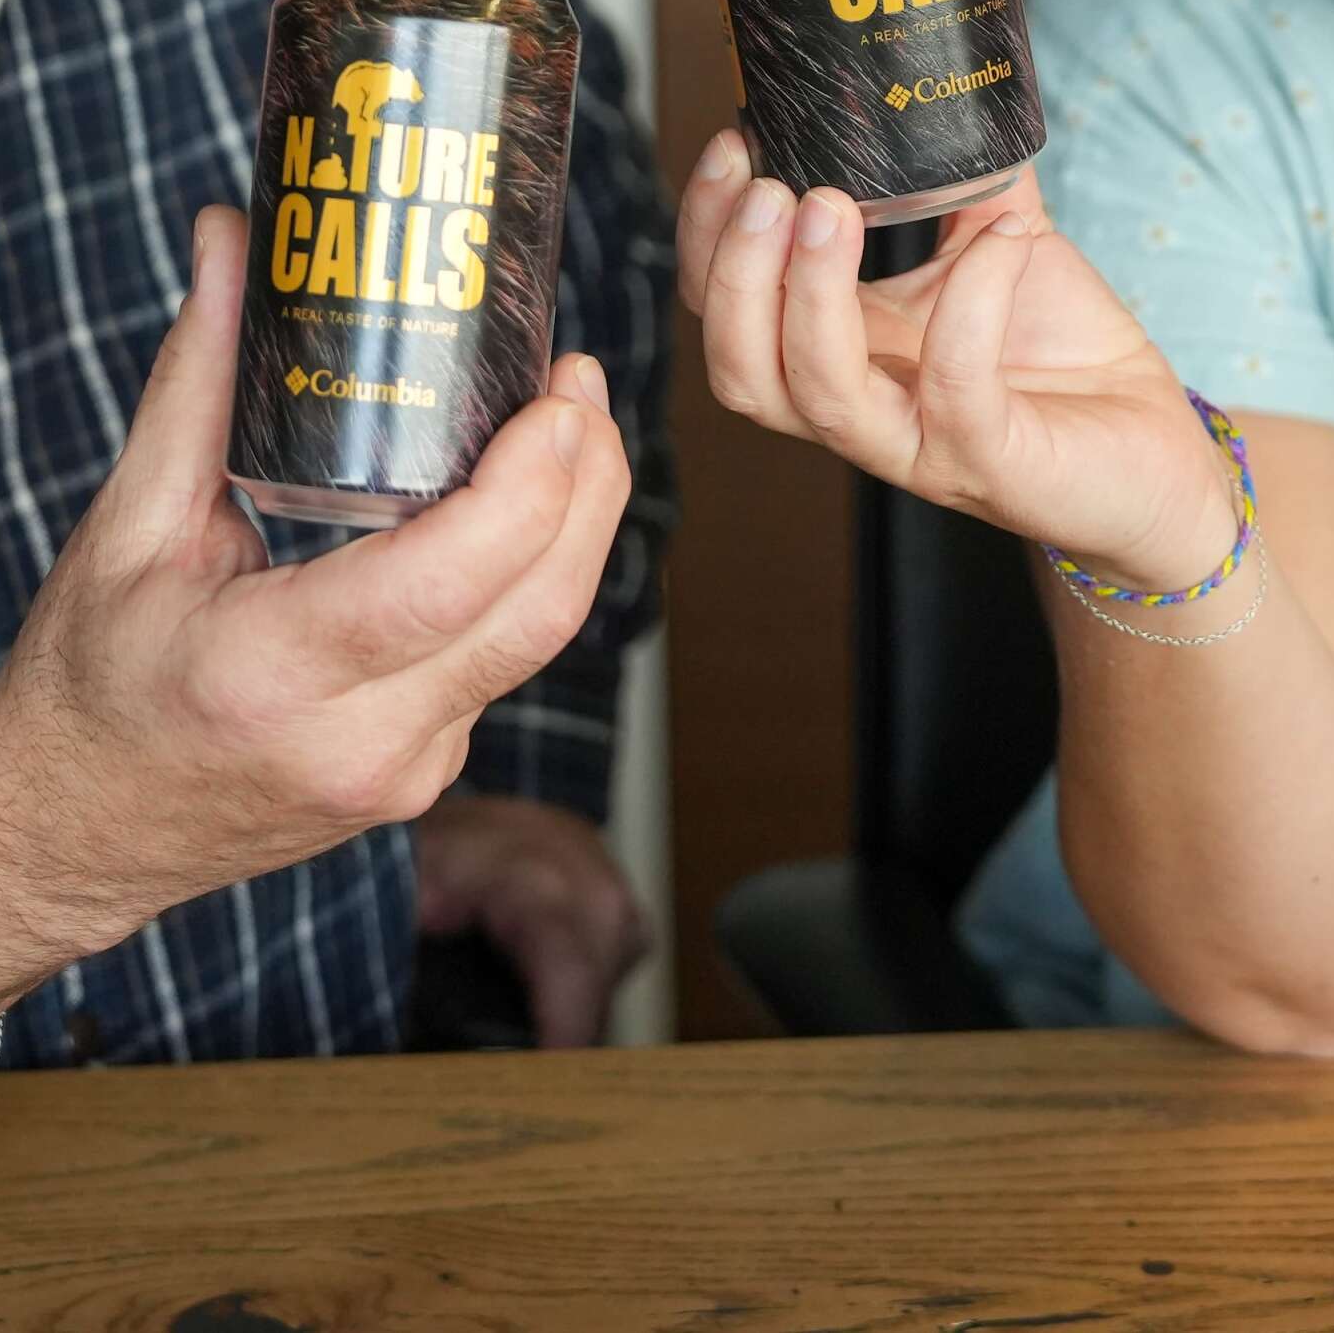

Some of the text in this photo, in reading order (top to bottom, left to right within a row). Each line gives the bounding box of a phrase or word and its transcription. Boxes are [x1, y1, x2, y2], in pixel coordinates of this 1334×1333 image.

[860, 34, 870, 46] A
[874, 28, 909, 43] REAL
[914, 14, 955, 34] TASTE
[956, 9, 971, 23] OF
[913, 57, 1013, 104] Columbia
[271, 192, 490, 312] CALLS
[281, 306, 460, 337] A REAL TASTE OF NATURE
[310, 369, 436, 408] Columbia
